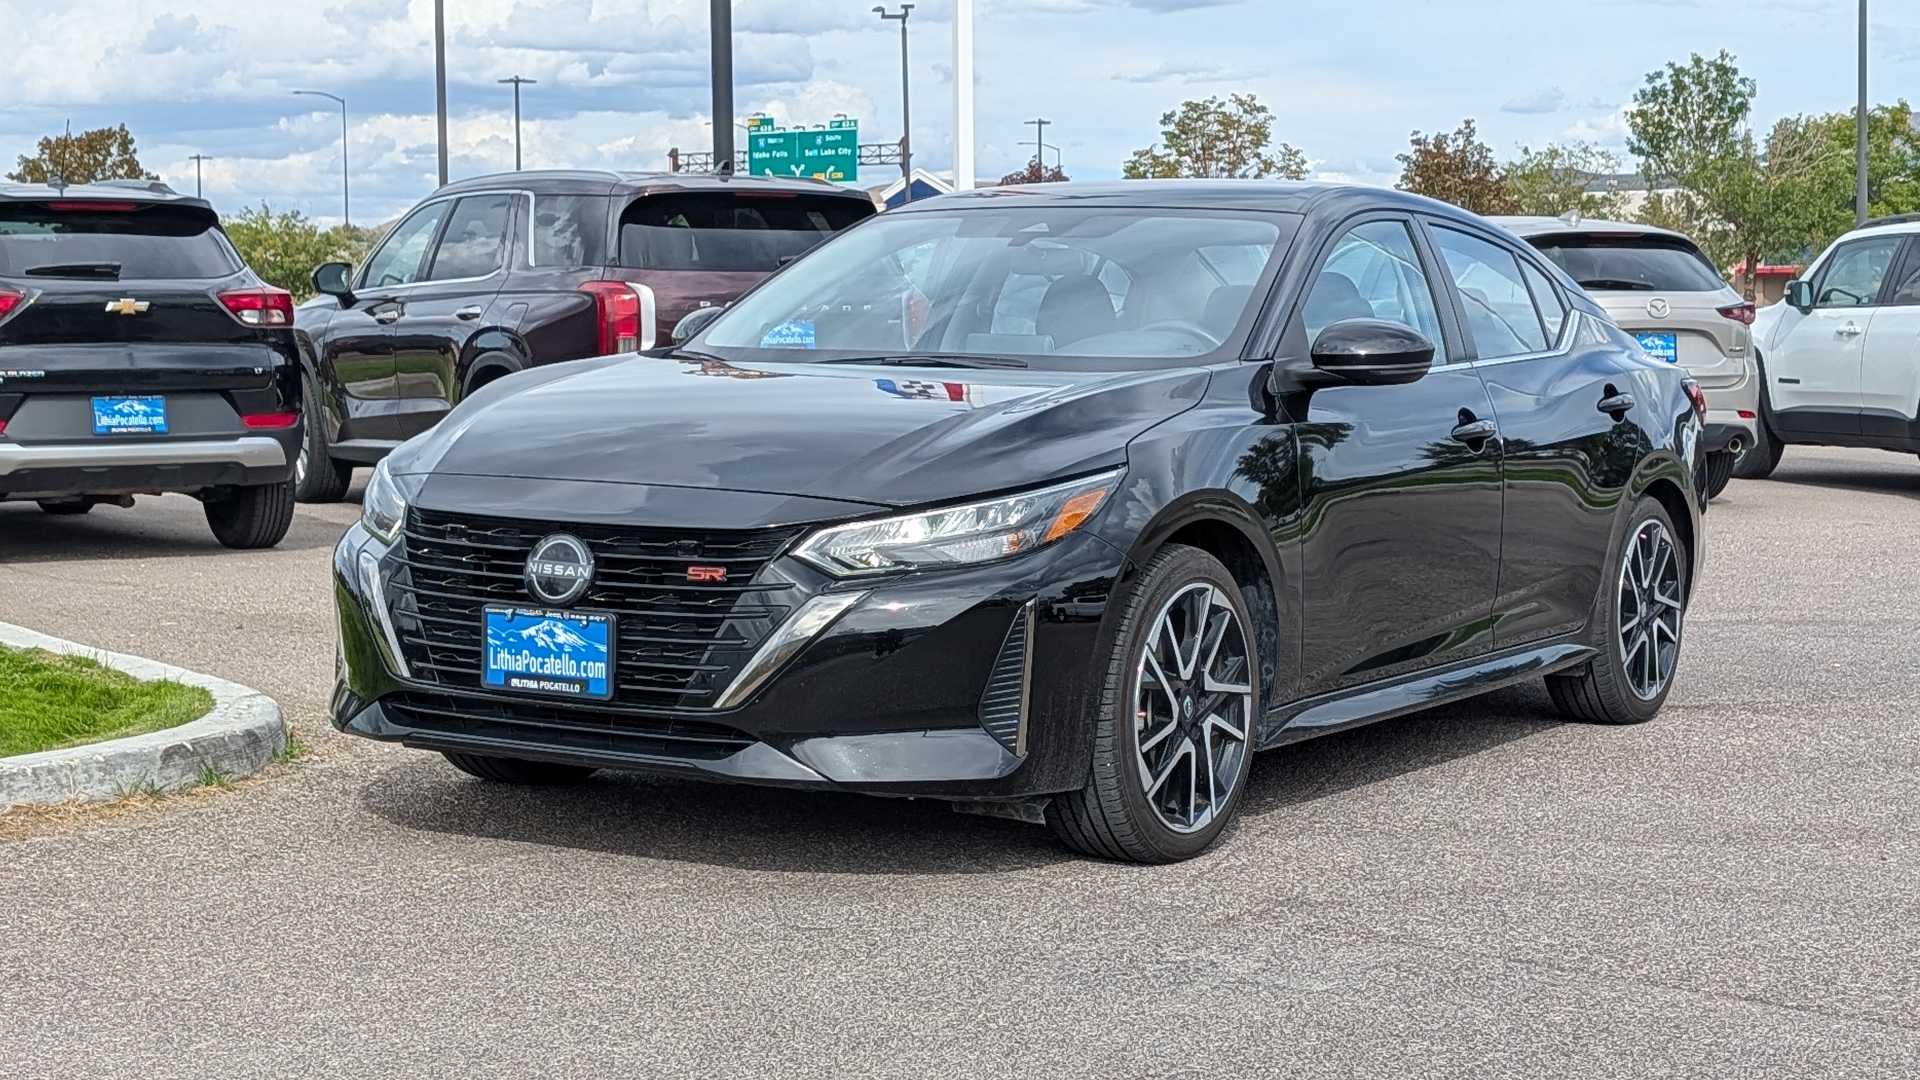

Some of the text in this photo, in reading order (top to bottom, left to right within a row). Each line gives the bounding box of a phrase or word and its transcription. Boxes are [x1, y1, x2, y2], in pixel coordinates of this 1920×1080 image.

[752, 150, 788, 159] Idaho Falls
[820, 148, 836, 156] Lake
[838, 147, 852, 156] City
[96, 414, 164, 426] LithiaPocatello.com
[529, 562, 589, 577] NISSAN
[687, 566, 727, 581] SR
[490, 647, 606, 679] LithiaPocatello.com
[540, 681, 580, 693] POCATELLO
